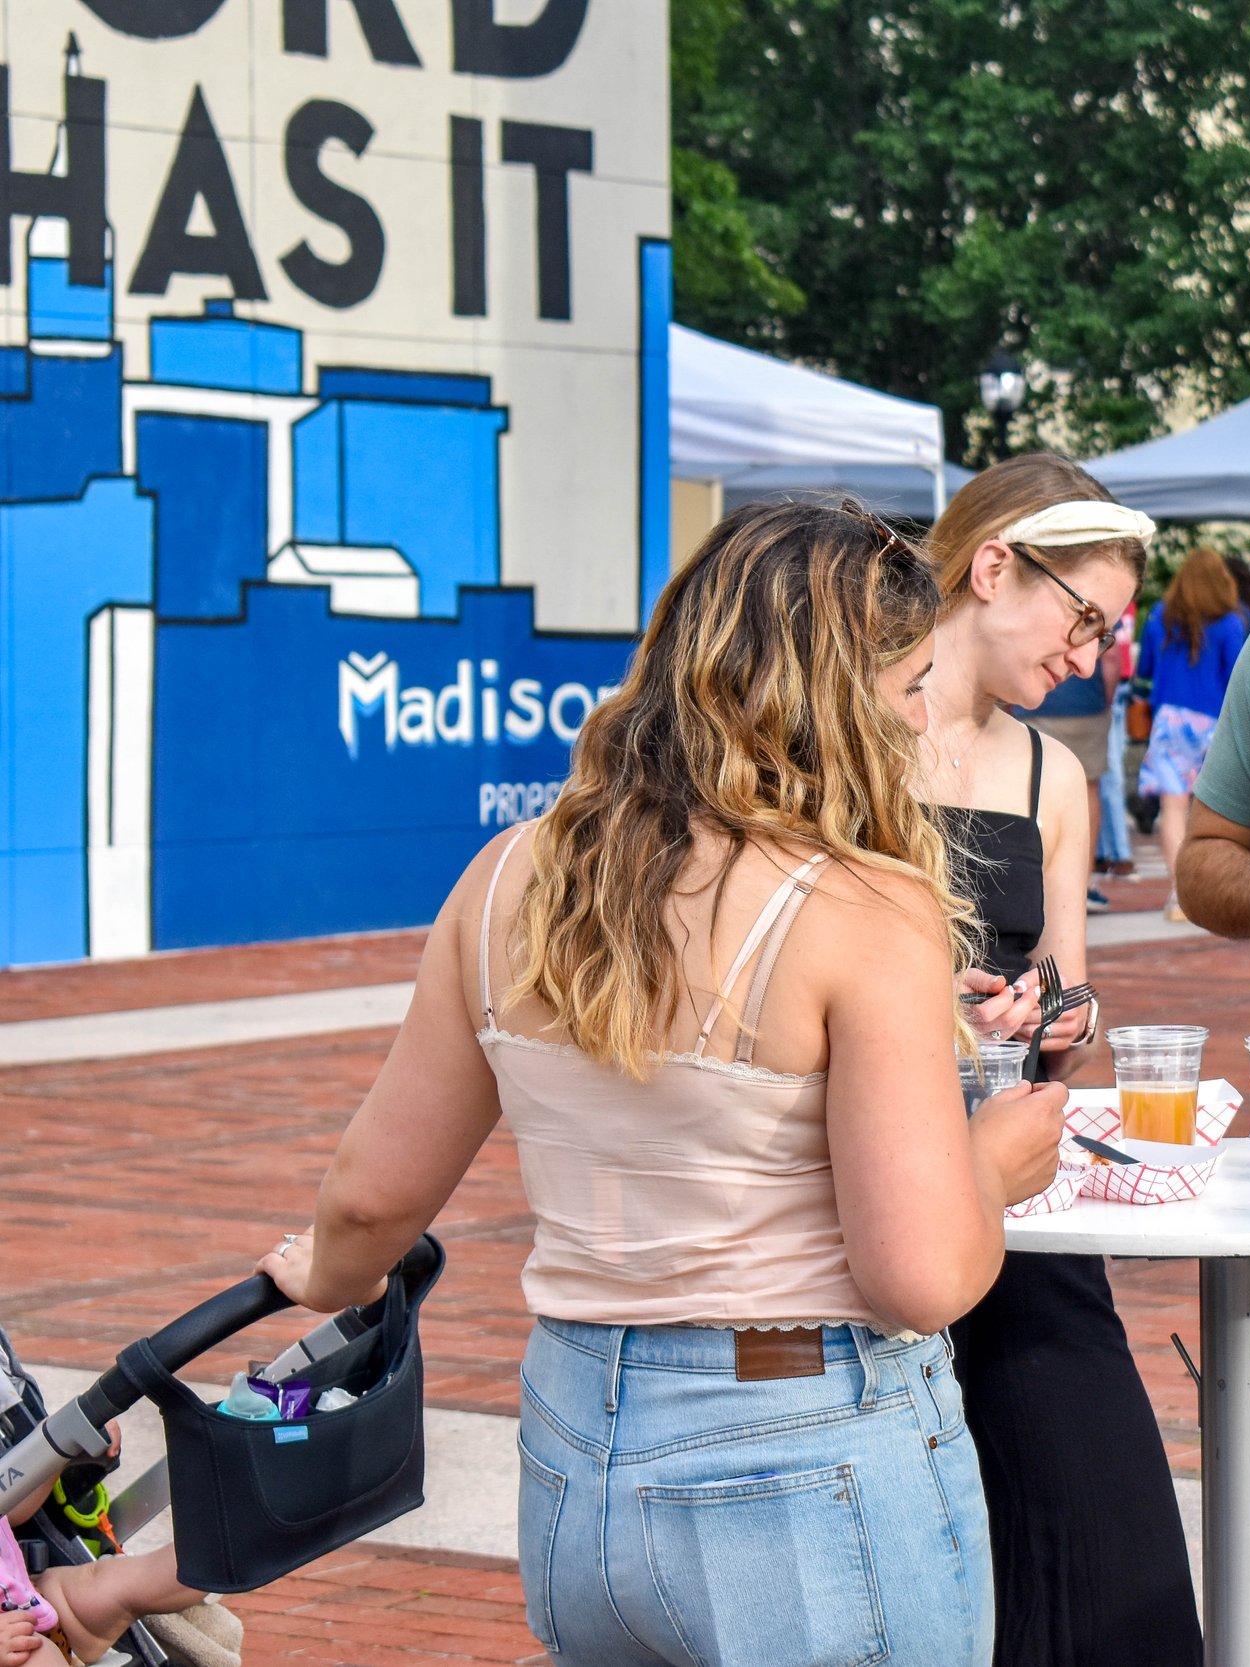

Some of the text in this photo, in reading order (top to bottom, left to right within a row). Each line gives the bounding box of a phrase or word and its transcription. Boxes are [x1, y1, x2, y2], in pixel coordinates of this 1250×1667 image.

[0, 62, 593, 321] HAS IT
[338, 651, 620, 757] Madiso
